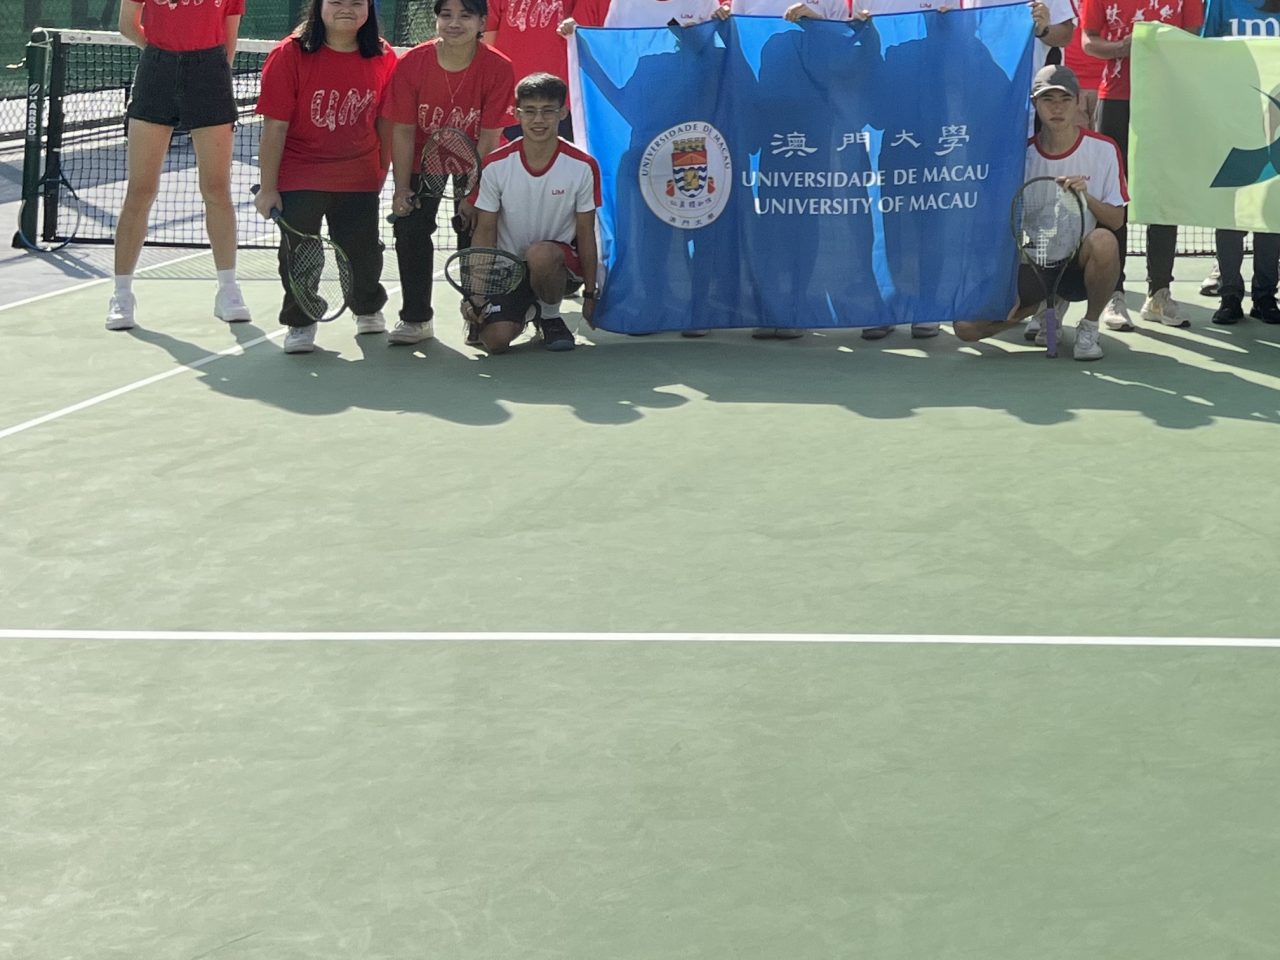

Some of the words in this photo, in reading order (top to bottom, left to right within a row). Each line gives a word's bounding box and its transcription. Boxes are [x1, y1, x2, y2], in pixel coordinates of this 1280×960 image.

[641, 123, 698, 176] UNIVERSIDADE
[713, 134, 731, 170] MACAU
[770, 124, 970, 158] 澳門大學
[742, 170, 886, 188] UNIVERSIDADE
[894, 168, 917, 185] DE
[923, 164, 990, 182] MACAU
[754, 197, 873, 215] UNIVERSITY
[877, 196, 905, 212] OF
[909, 191, 978, 210] MACAU
